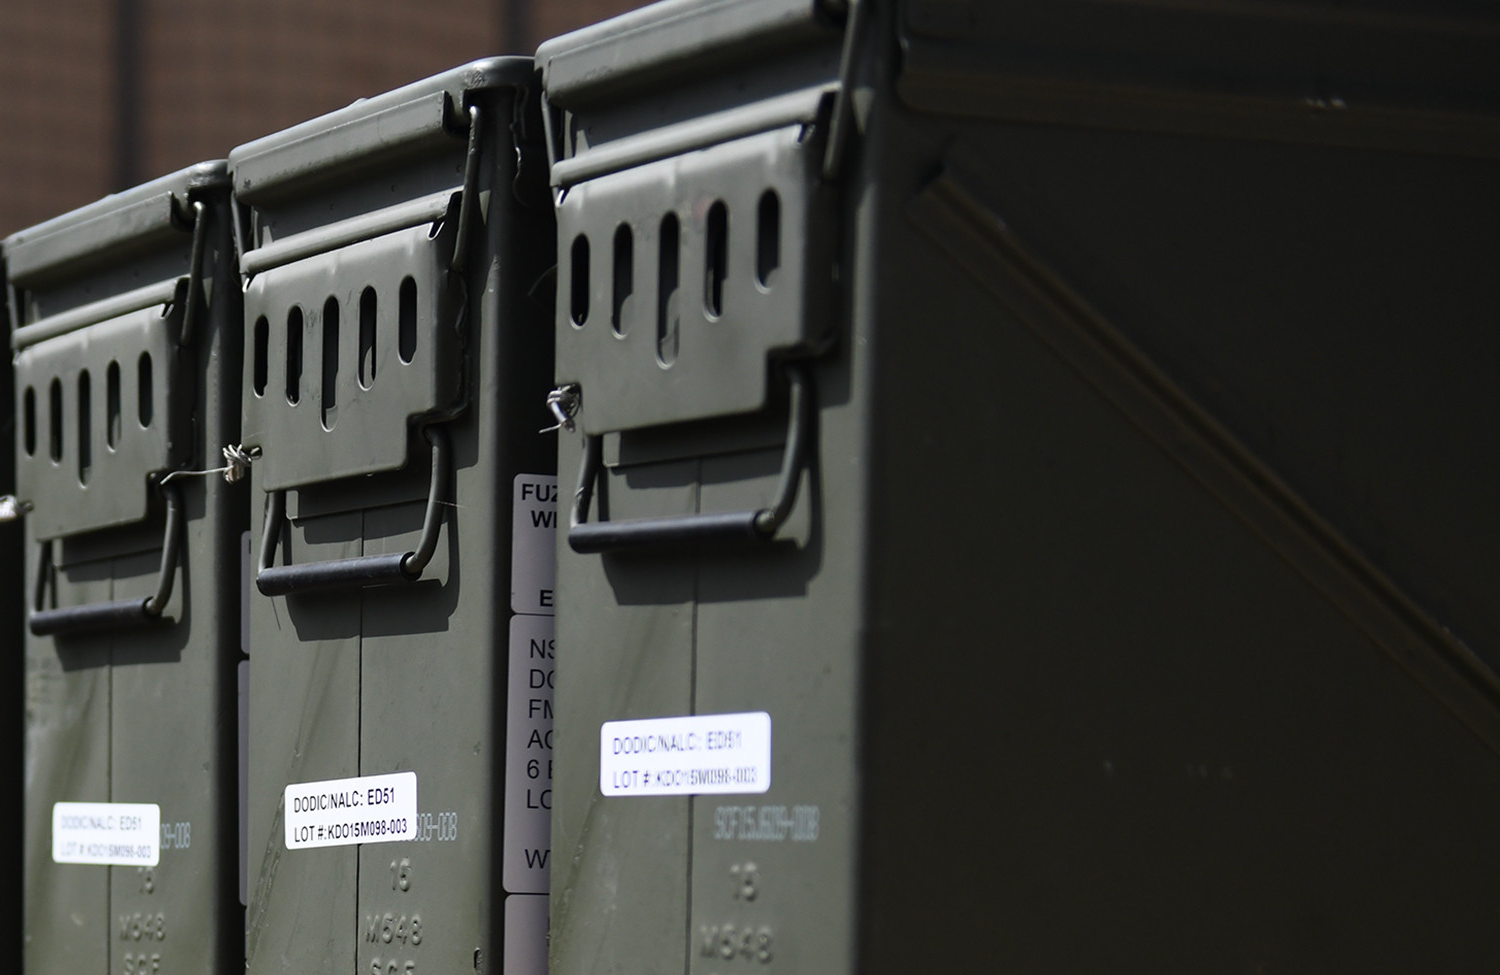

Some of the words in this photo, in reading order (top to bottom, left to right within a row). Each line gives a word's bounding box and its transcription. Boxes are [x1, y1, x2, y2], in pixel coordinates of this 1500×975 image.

[707, 730, 742, 751] ED51
[526, 759, 540, 779] 6
[613, 770, 639, 789] LOT
[293, 790, 363, 813] DODIC/NALC:
[367, 787, 395, 806] ED51
[294, 825, 315, 842] LOT
[362, 913, 423, 946] M548
